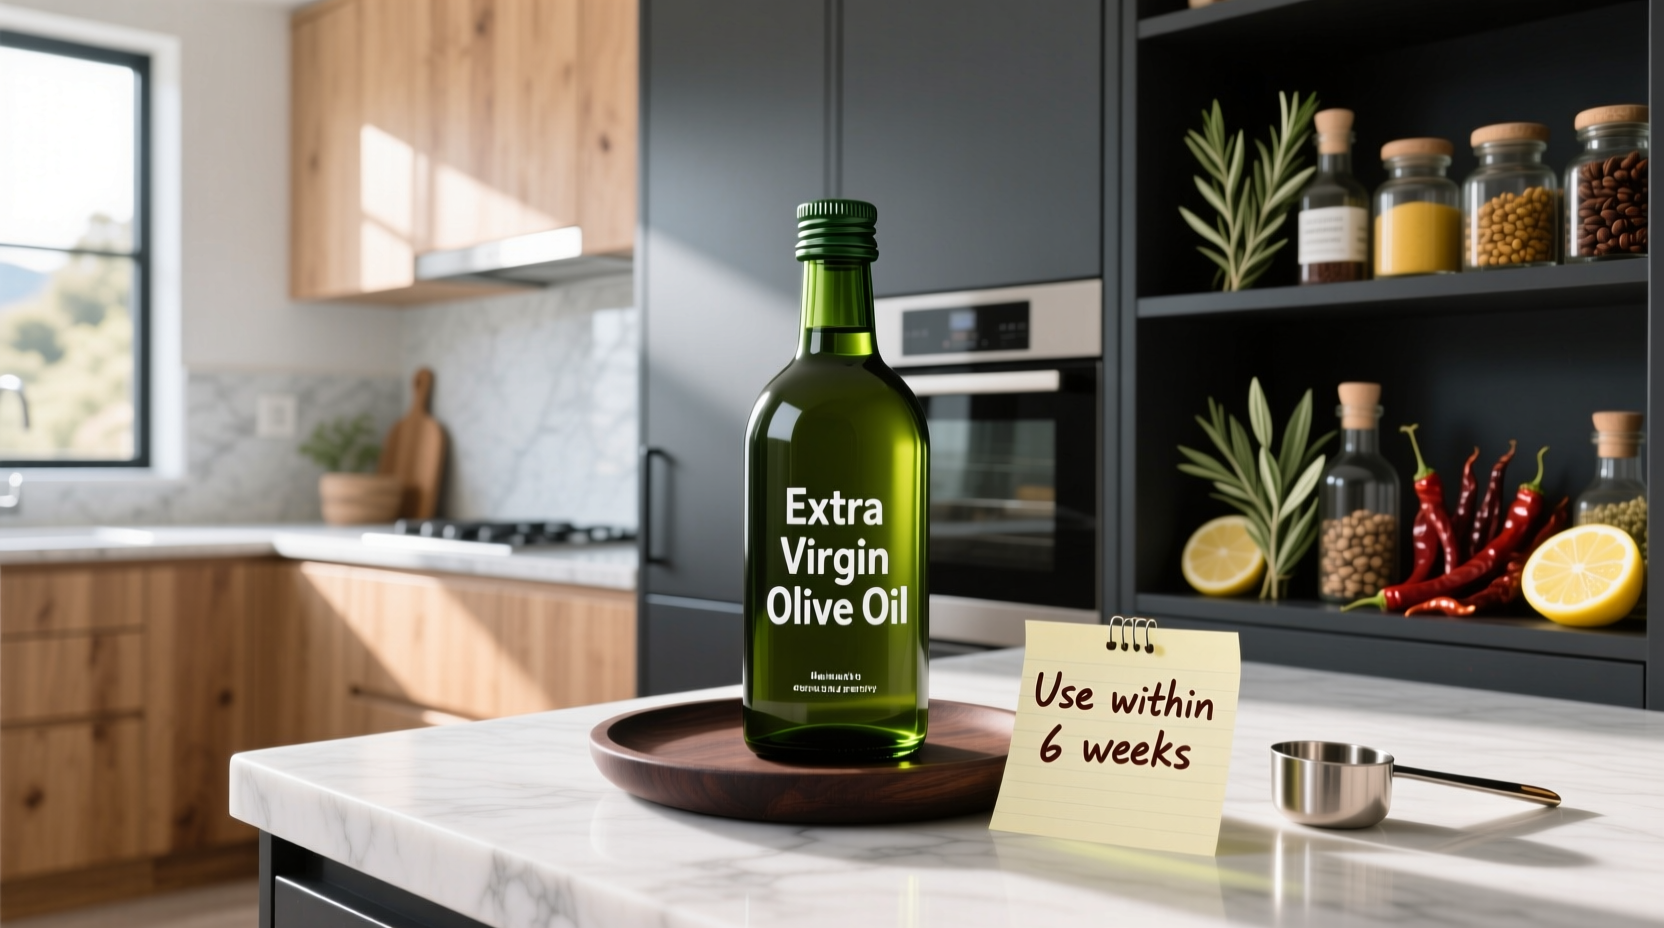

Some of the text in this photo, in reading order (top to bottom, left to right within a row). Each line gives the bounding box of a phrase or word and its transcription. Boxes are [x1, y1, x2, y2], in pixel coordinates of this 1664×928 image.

[786, 487, 883, 526] Extra
[780, 536, 889, 586] Virgin
[766, 585, 908, 626] Olive Oil
[1035, 671, 1214, 721] Use within
[1040, 723, 1192, 770] 6 weeks
